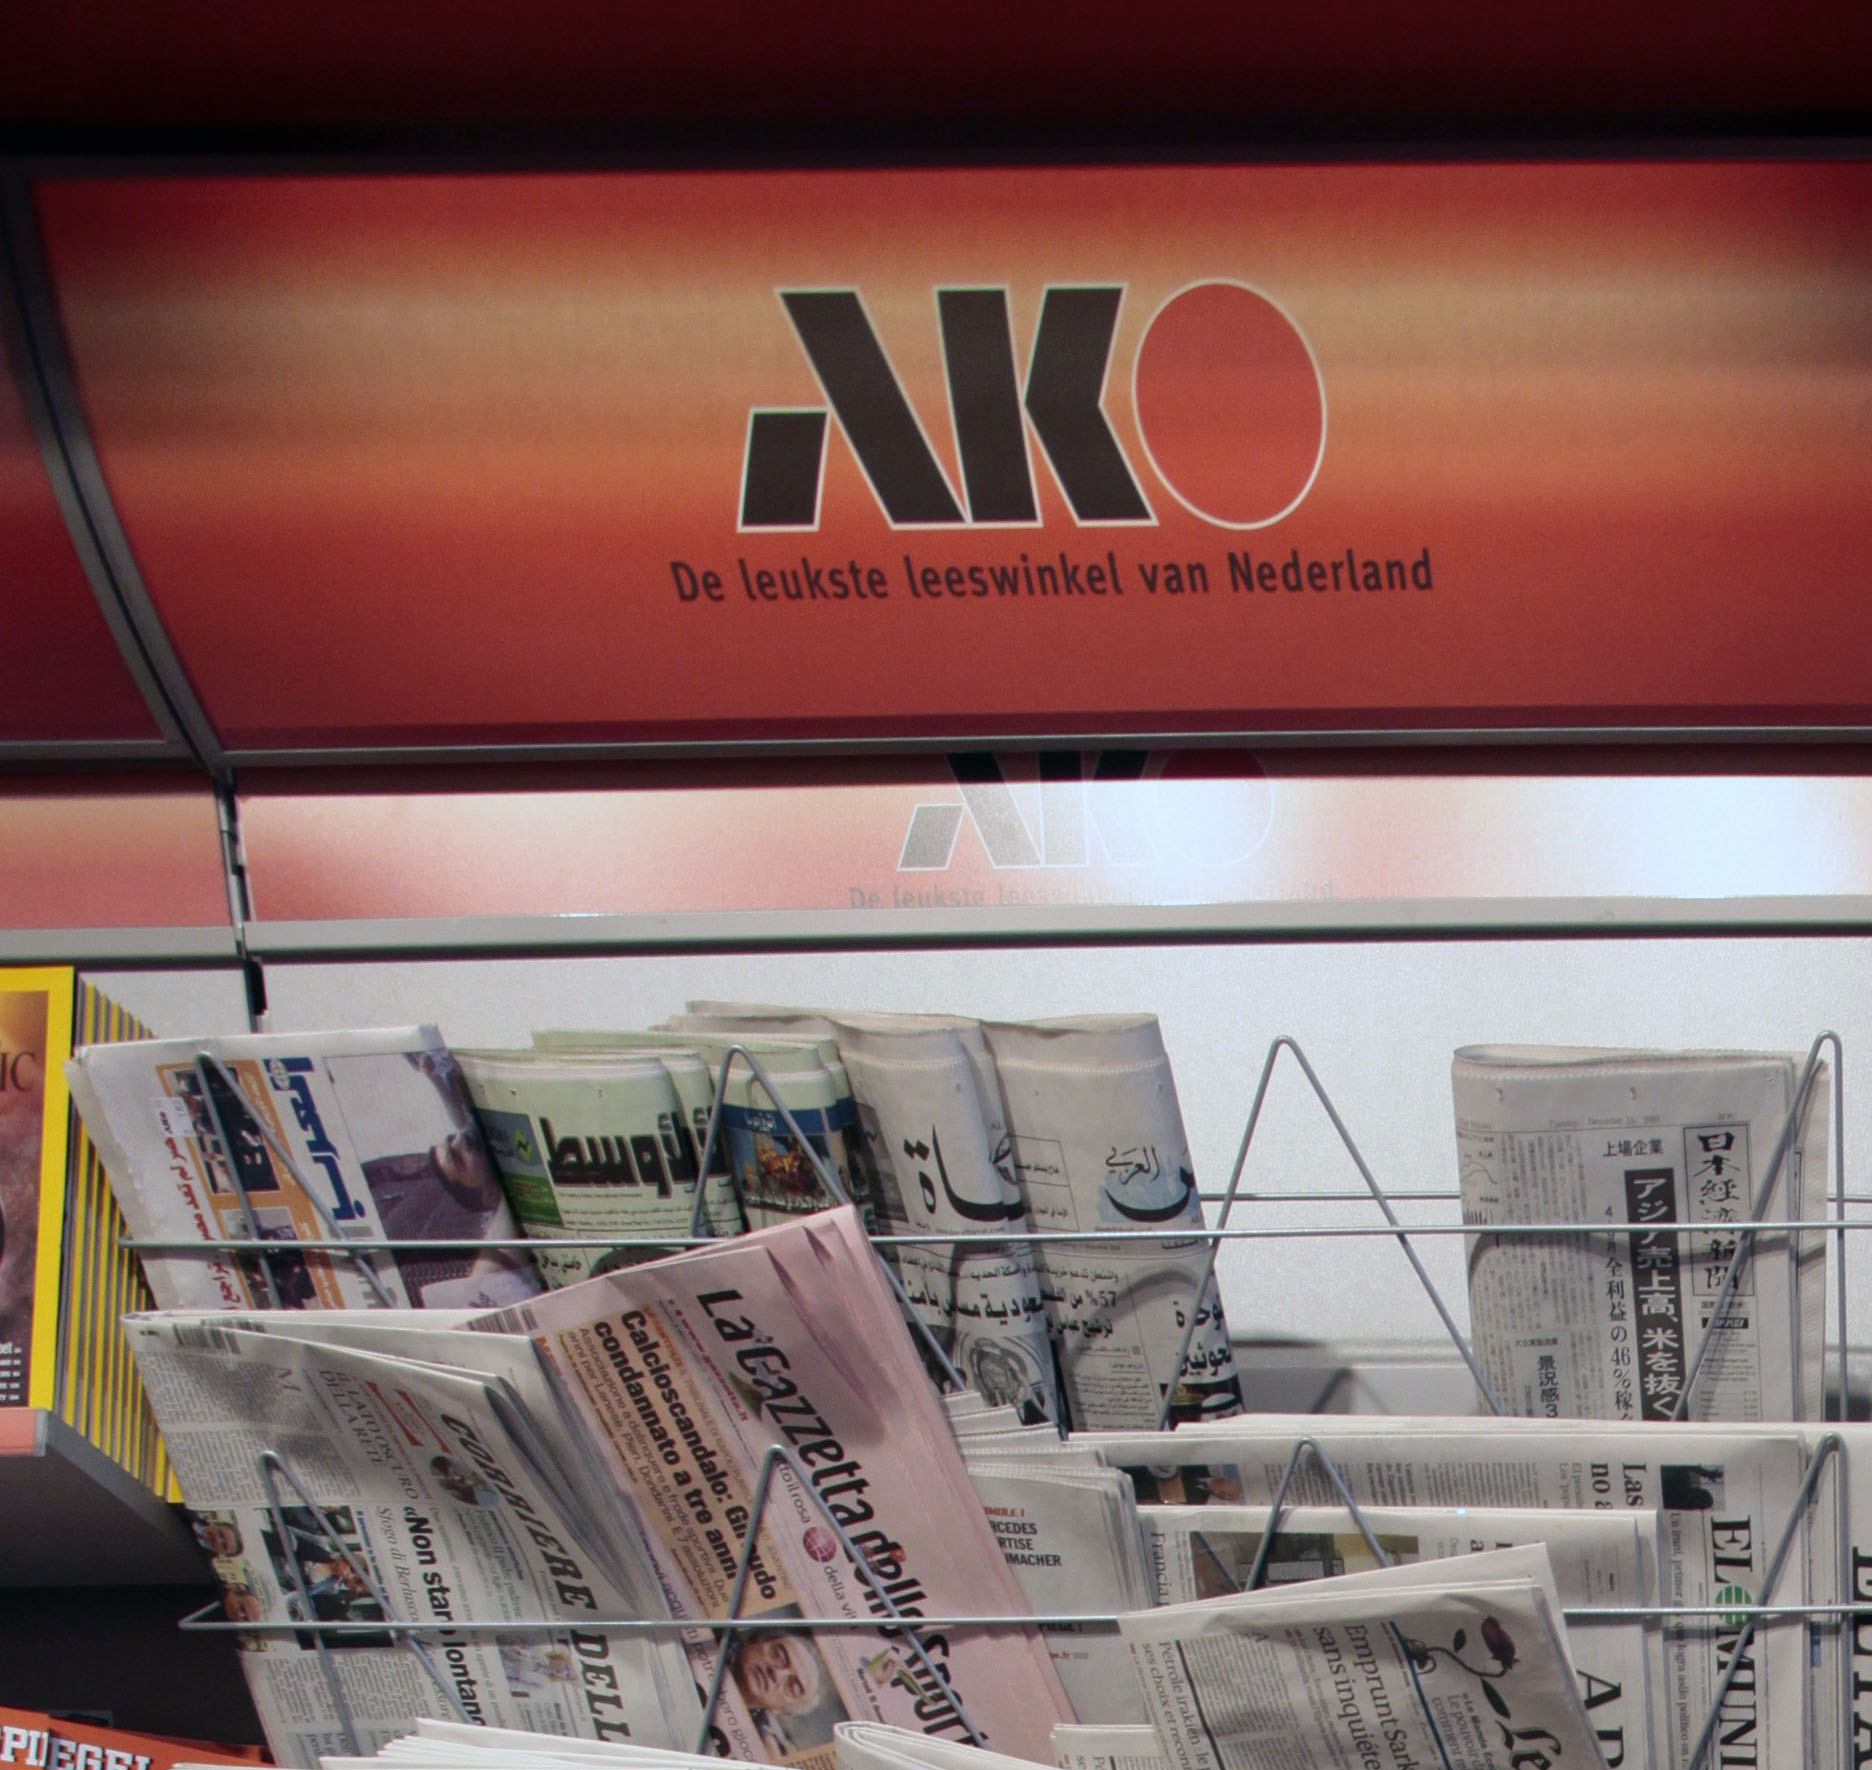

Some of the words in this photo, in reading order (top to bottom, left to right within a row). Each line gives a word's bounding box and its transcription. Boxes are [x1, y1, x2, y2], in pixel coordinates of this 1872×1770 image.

[736, 275, 1328, 533] AKO
[669, 560, 725, 603] De
[738, 557, 890, 602] leukste
[904, 552, 1122, 599] leeswinkel
[1139, 559, 1209, 595] van
[1228, 547, 1434, 594] Nederland
[1602, 1138, 1664, 1157] 上場企業
[595, 1321, 682, 1467] condannato
[621, 1308, 734, 1503] Calcioscandalo:
